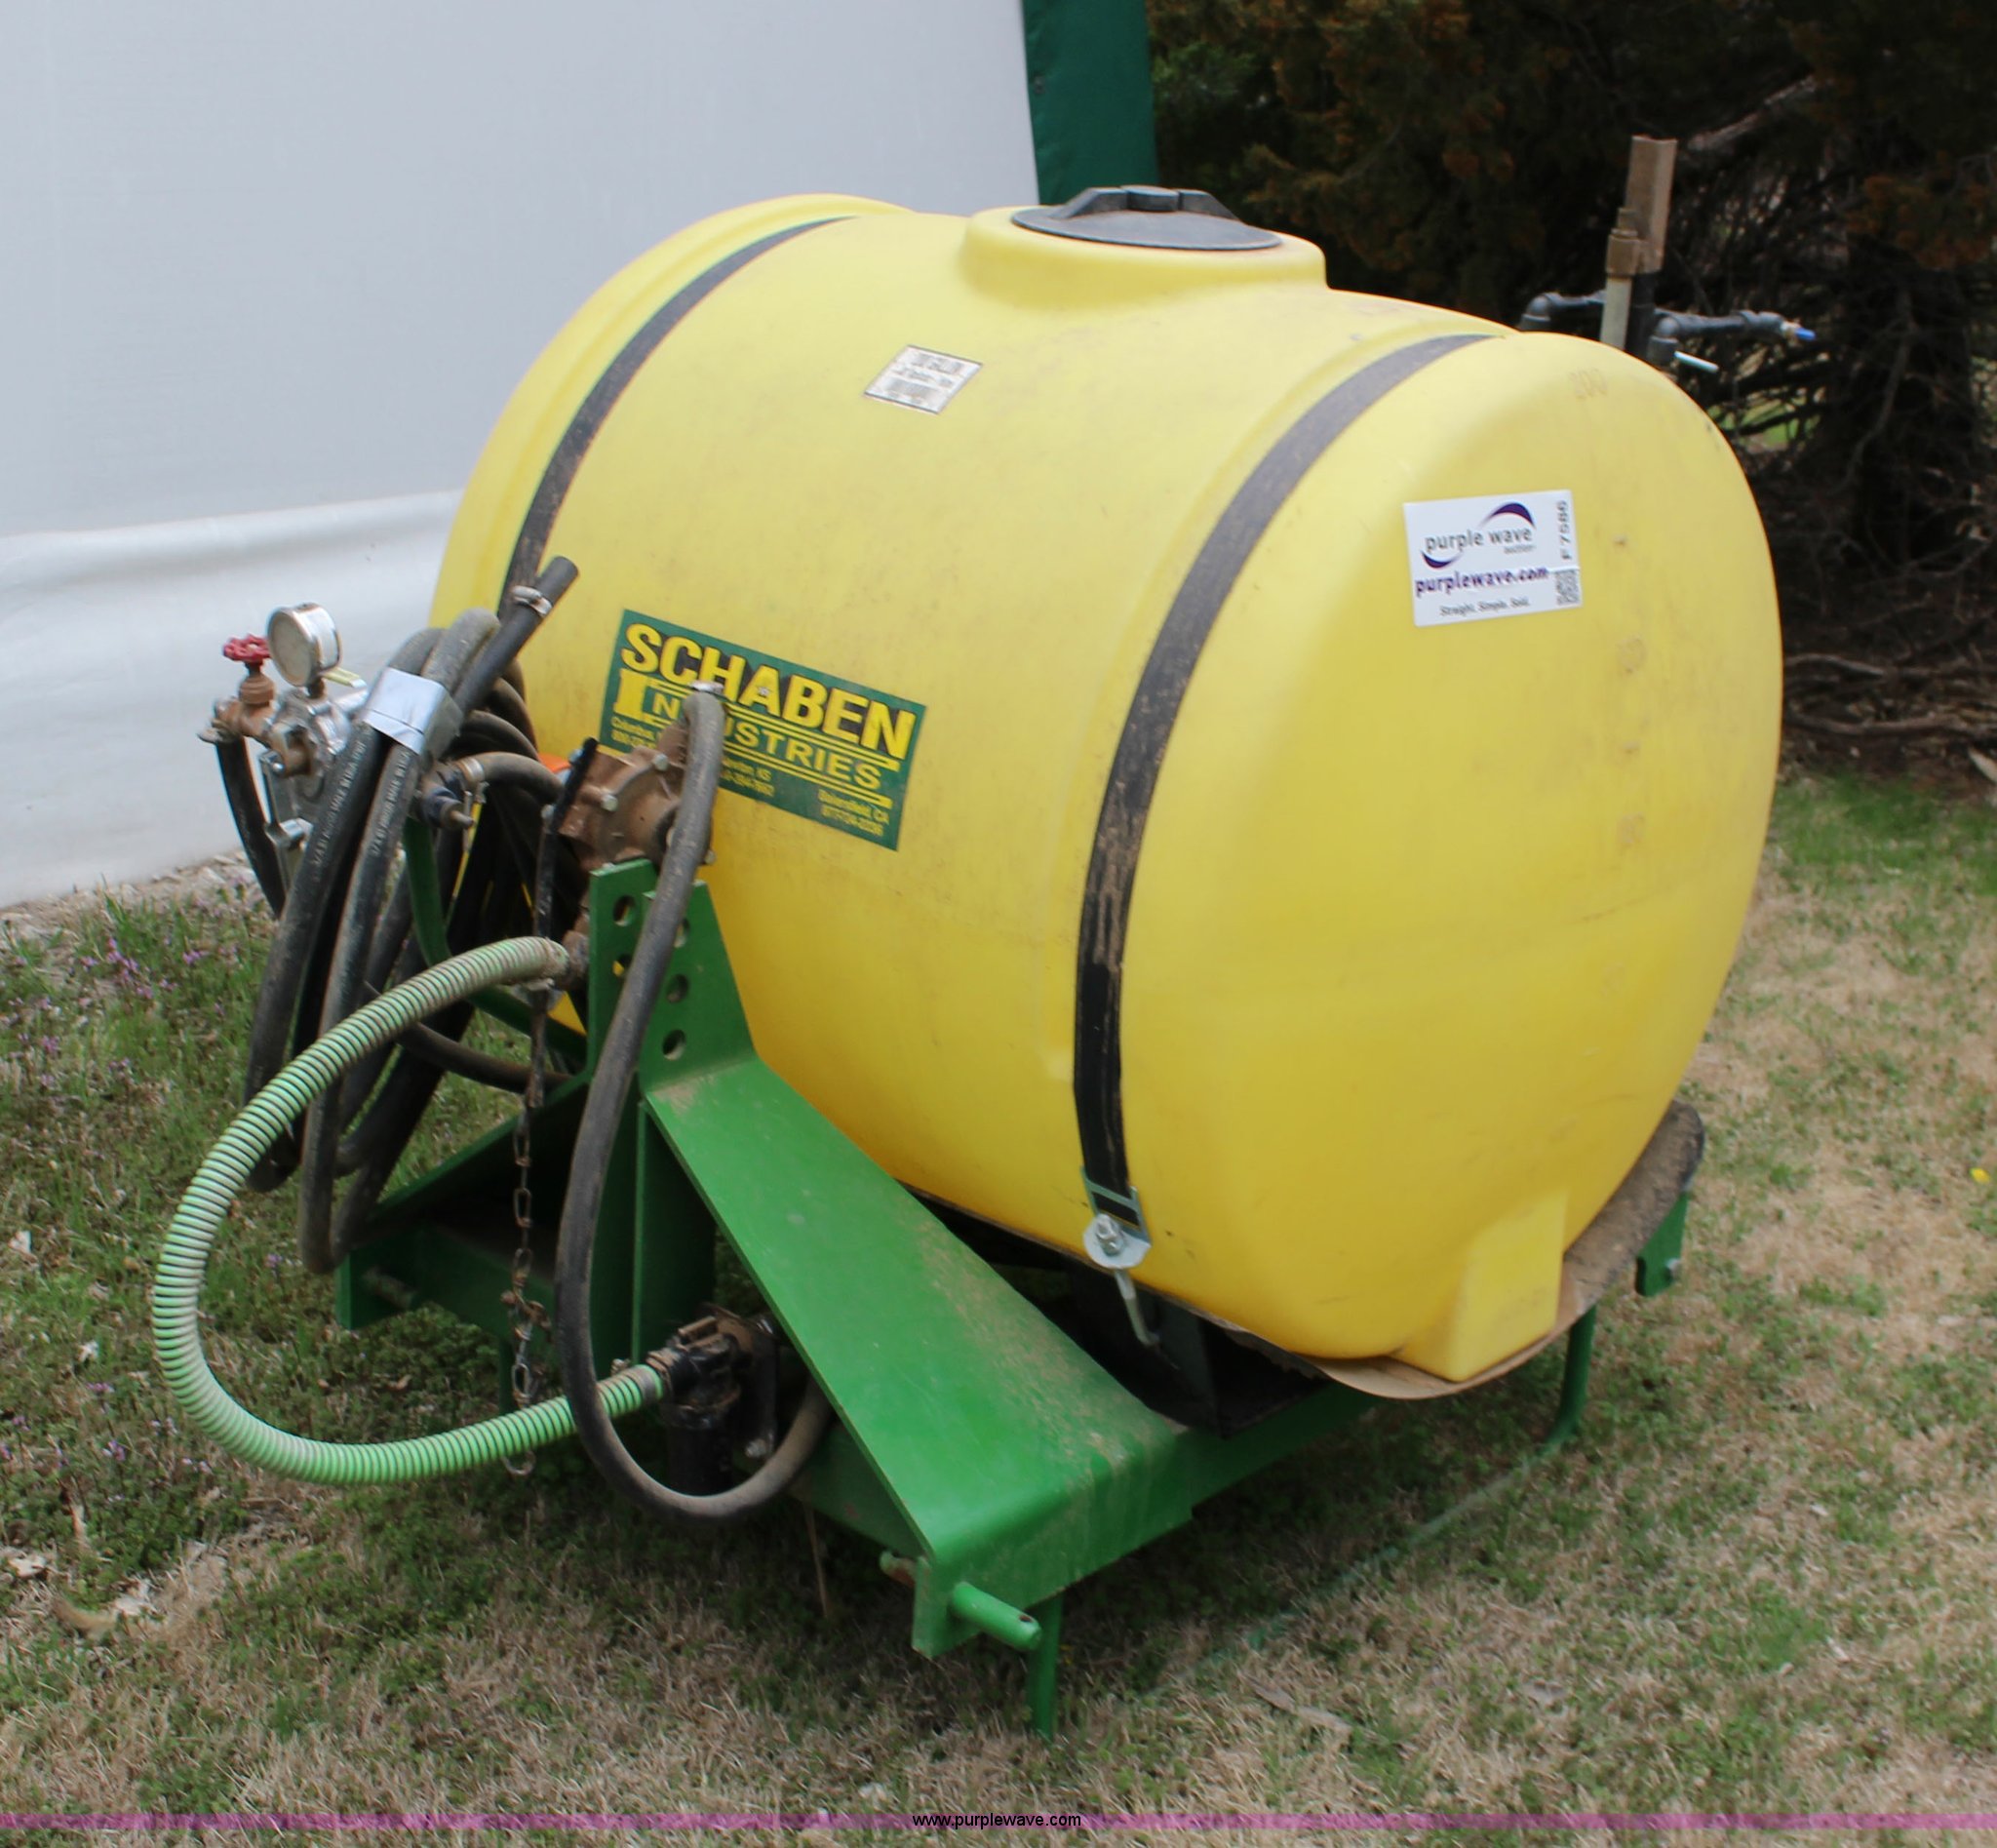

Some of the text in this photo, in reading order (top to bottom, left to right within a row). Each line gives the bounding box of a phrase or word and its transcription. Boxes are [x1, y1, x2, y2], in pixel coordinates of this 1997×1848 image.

[1426, 528, 1533, 554] purple wave
[1415, 568, 1548, 598] purplewave.com
[613, 667, 881, 791] INSTRIES
[620, 622, 917, 761] SCHABEN
